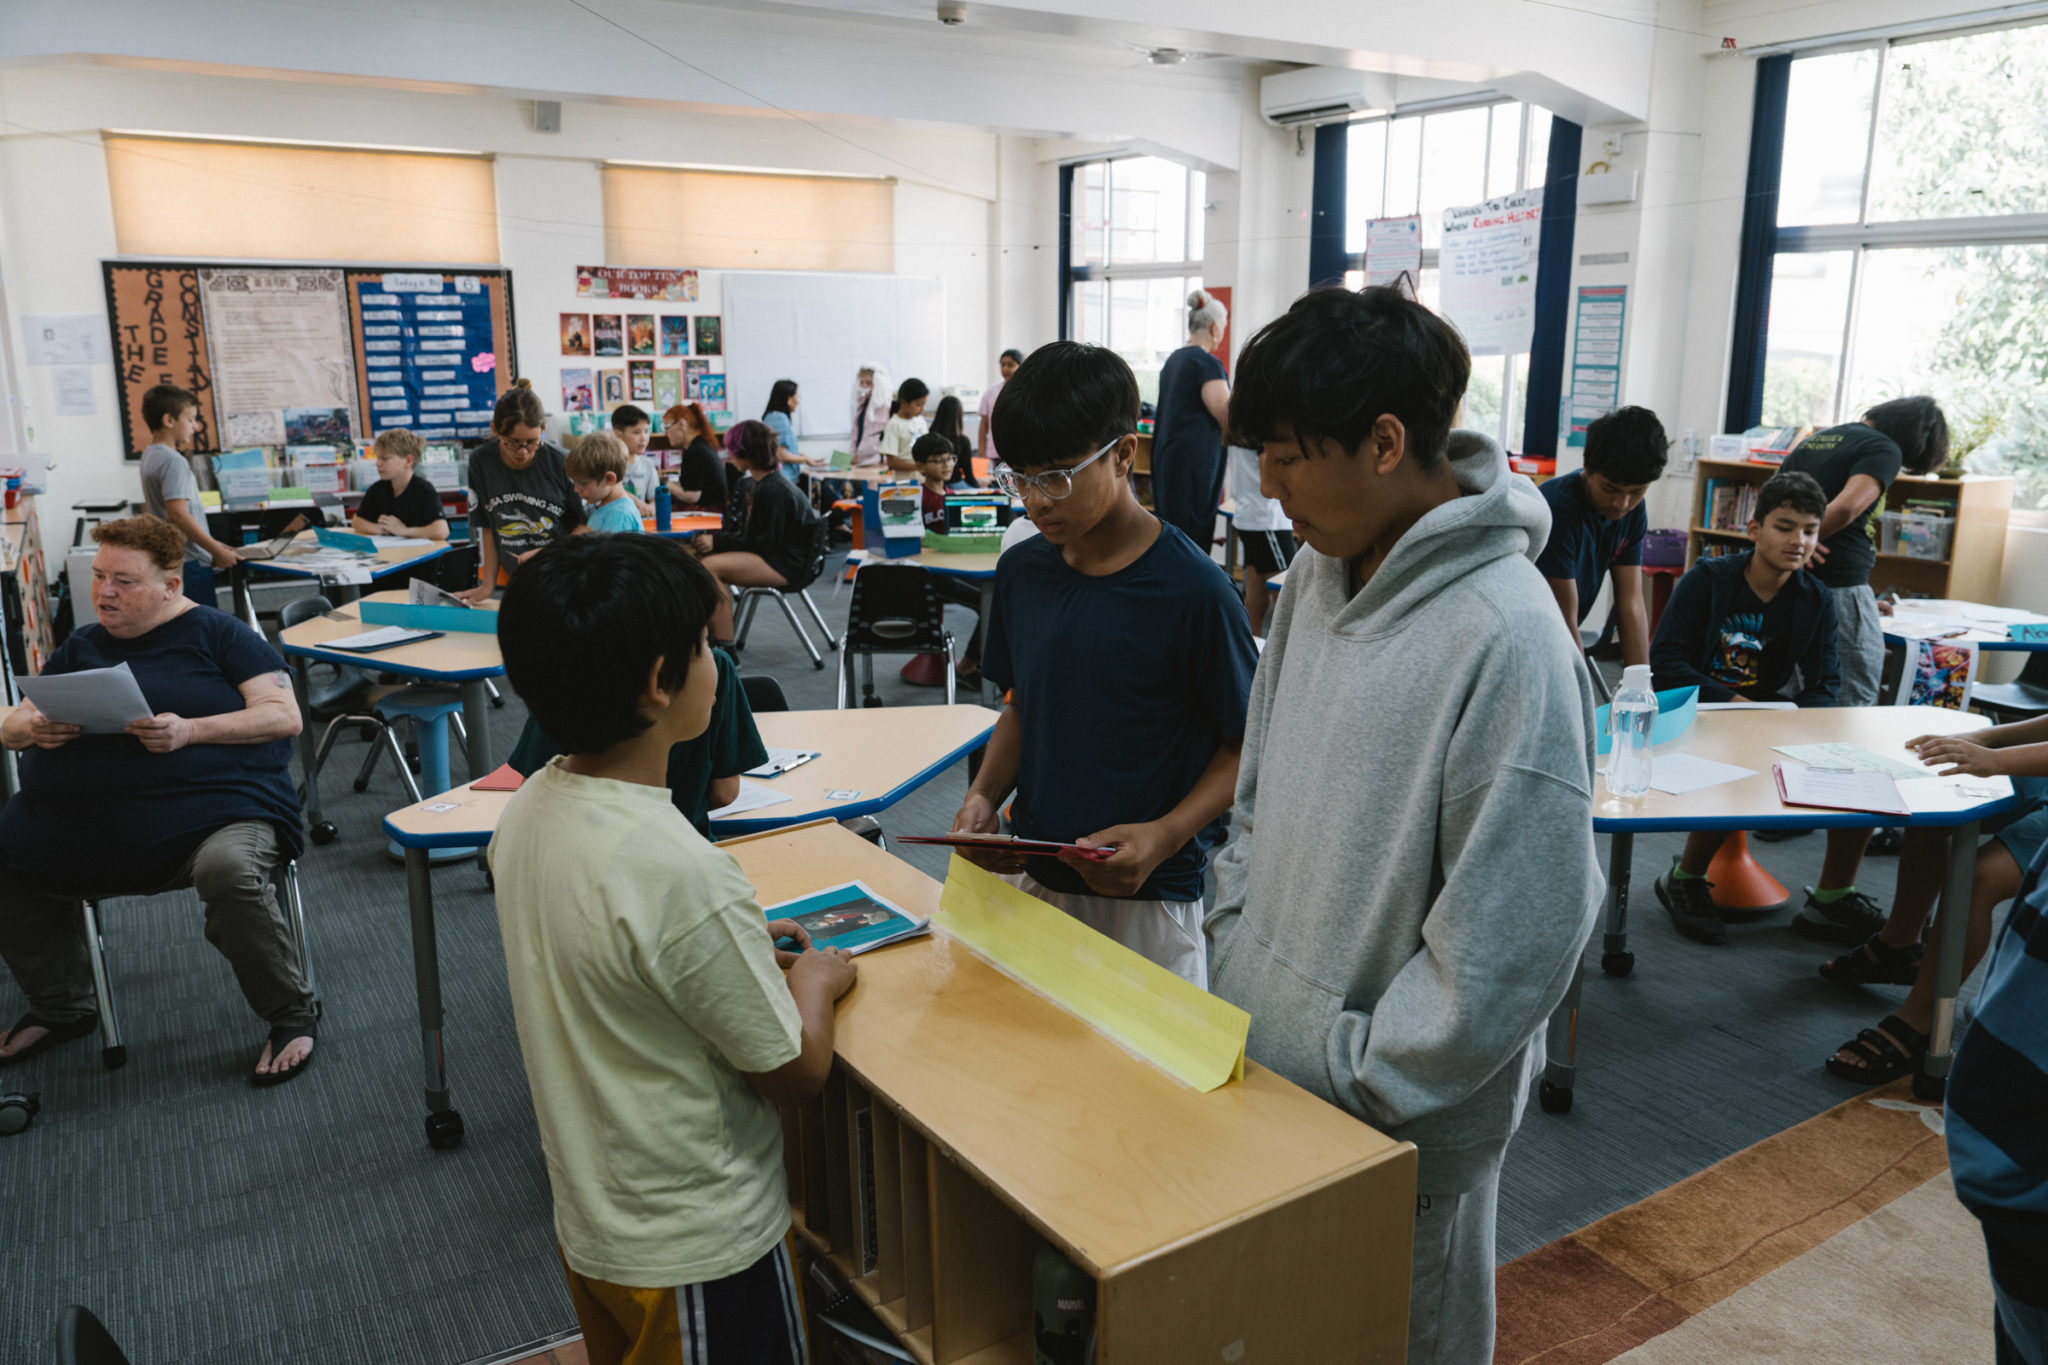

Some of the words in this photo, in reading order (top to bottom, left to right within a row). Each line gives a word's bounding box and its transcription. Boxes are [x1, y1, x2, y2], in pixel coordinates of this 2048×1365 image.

[597, 270, 625, 280] OUR
[628, 270, 651, 280] TOP
[653, 271, 677, 281] TEN
[463, 279, 473, 291] 6
[618, 283, 659, 294] BOOKS
[124, 325, 146, 384] THE
[1057, 1298, 1086, 1310] MARVEL
